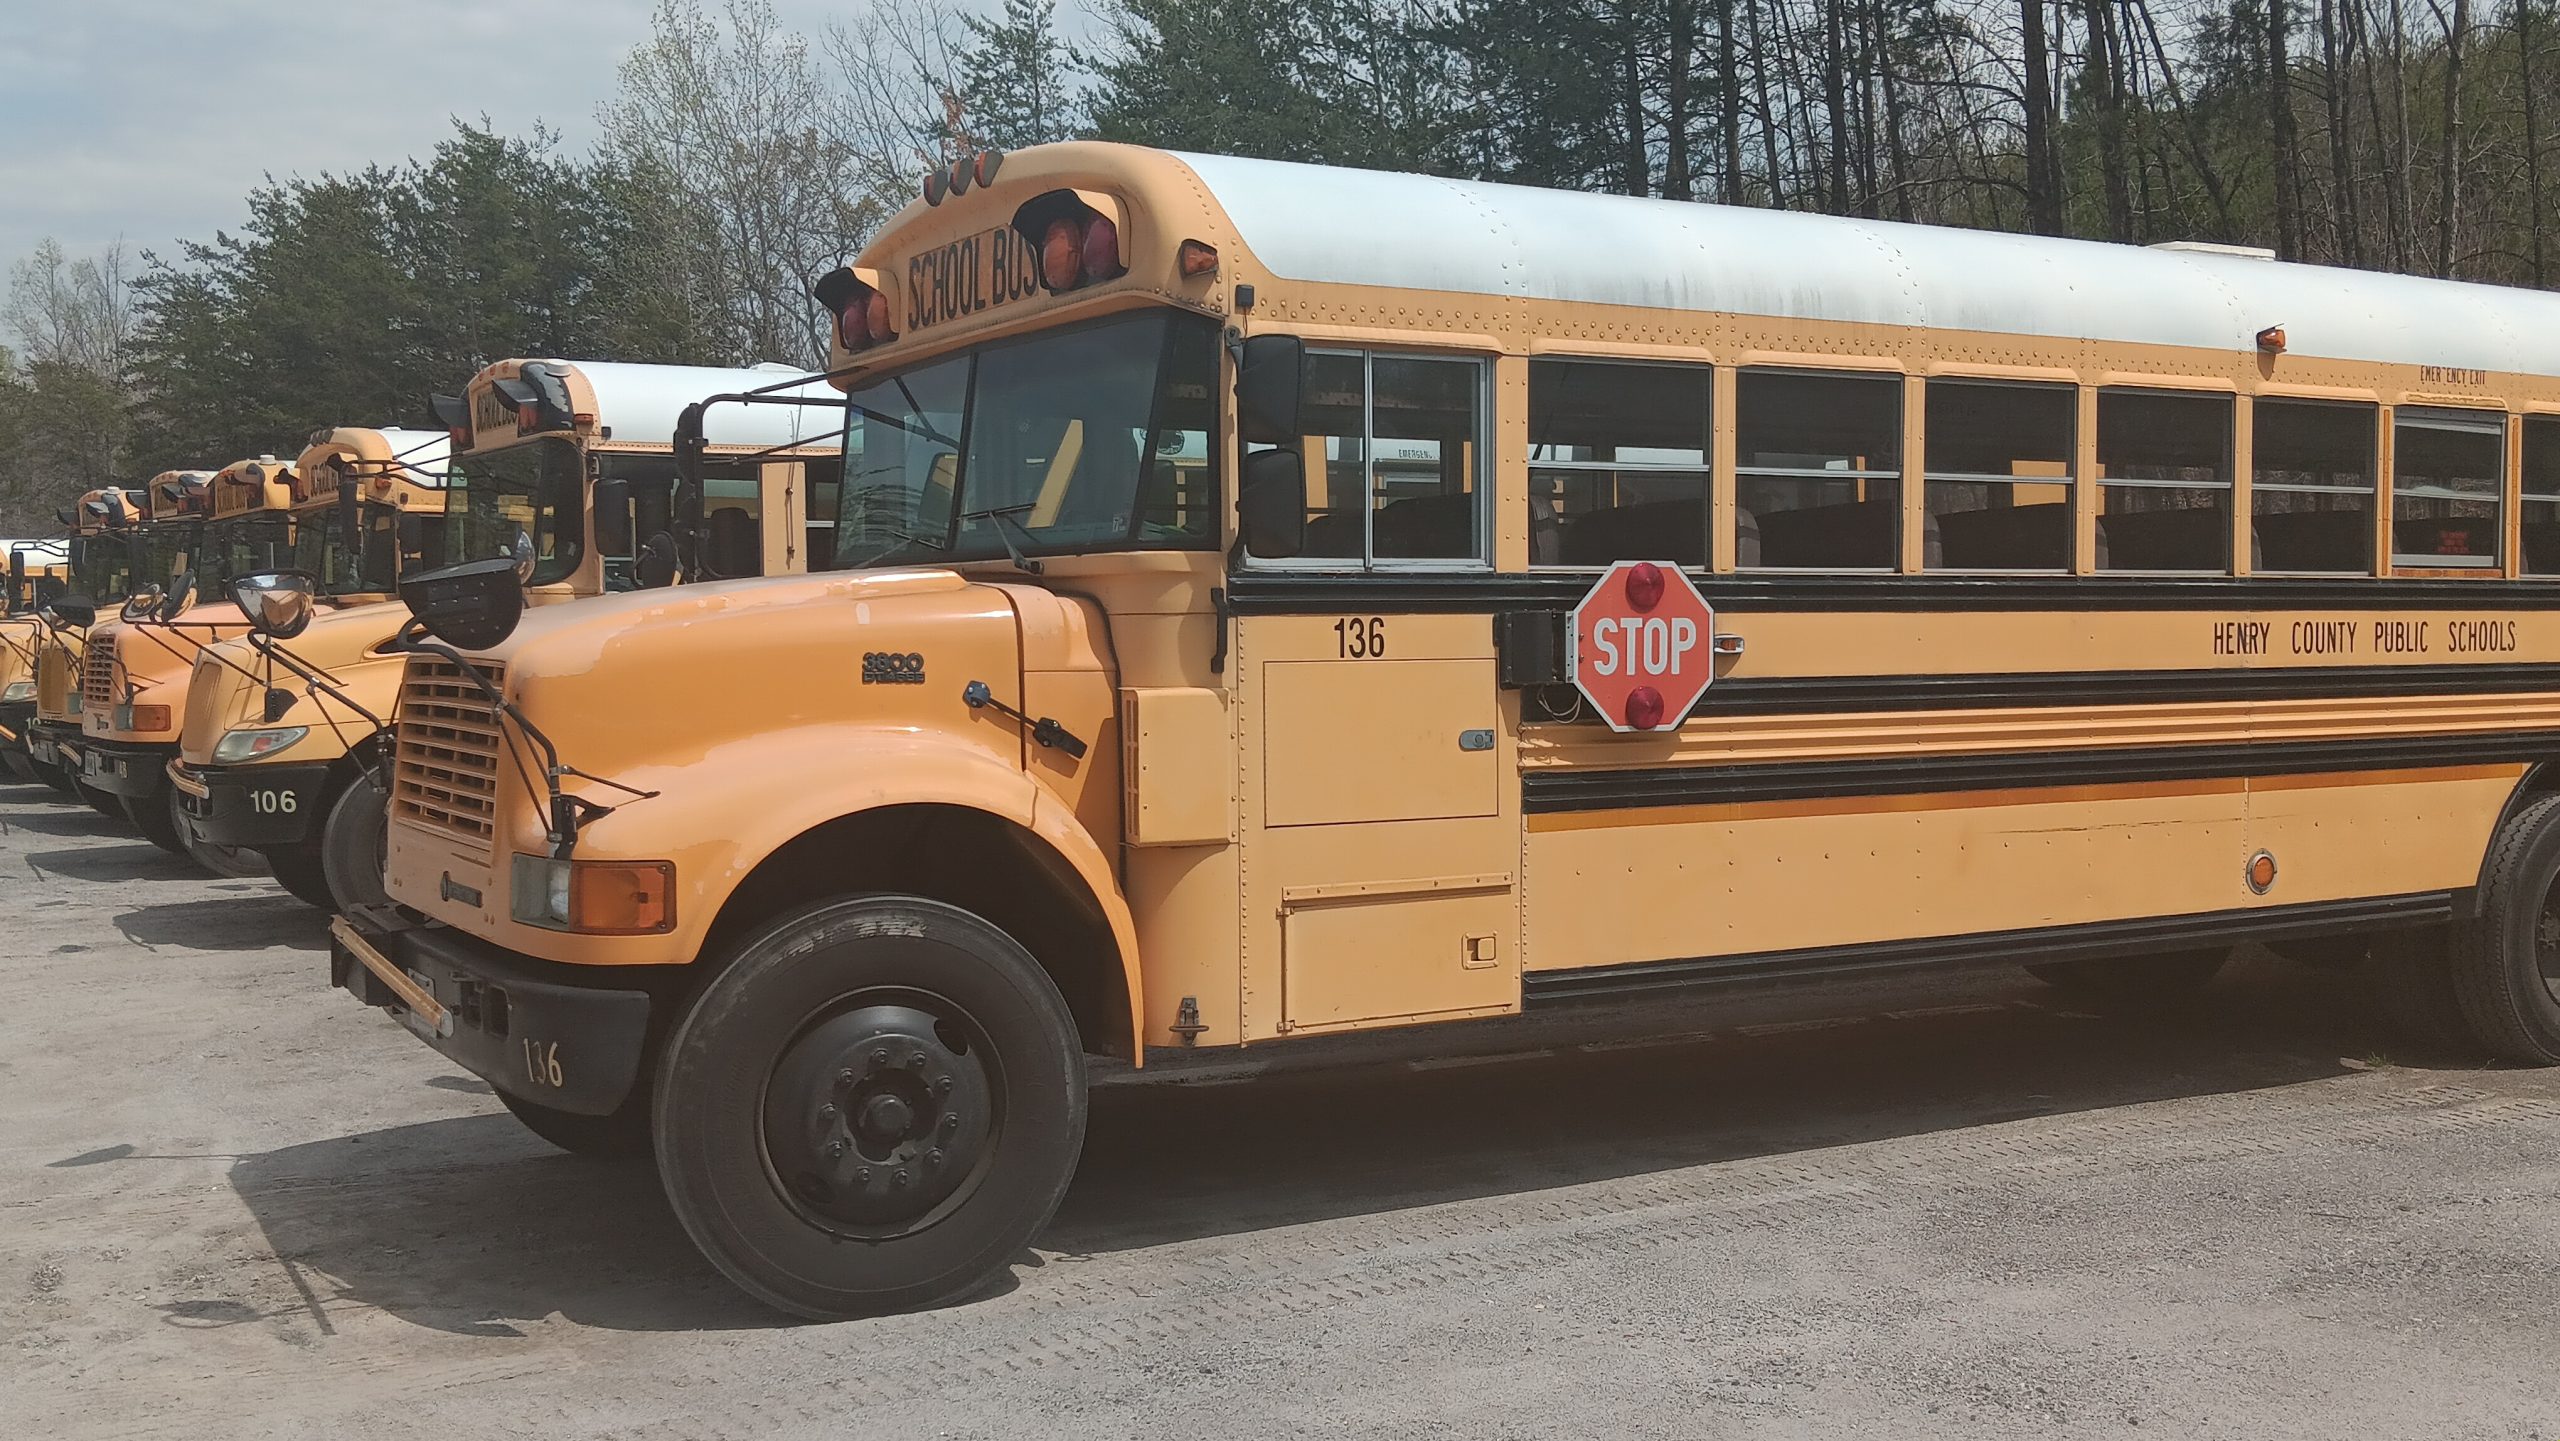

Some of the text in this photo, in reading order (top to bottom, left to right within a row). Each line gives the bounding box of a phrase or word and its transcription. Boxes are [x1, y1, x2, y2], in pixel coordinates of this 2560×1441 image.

[908, 223, 1039, 331] SCHOOL BUS
[2420, 365, 2486, 385] EMERENCY EXIT
[1334, 617, 1385, 659] 136
[1593, 617, 1697, 676] STOP
[2213, 619, 2517, 655] HENRY COUNTY PUBLIC SCHOOLS
[862, 652, 925, 671] 3800
[249, 790, 297, 813] 106
[523, 1037, 563, 1088] 136
